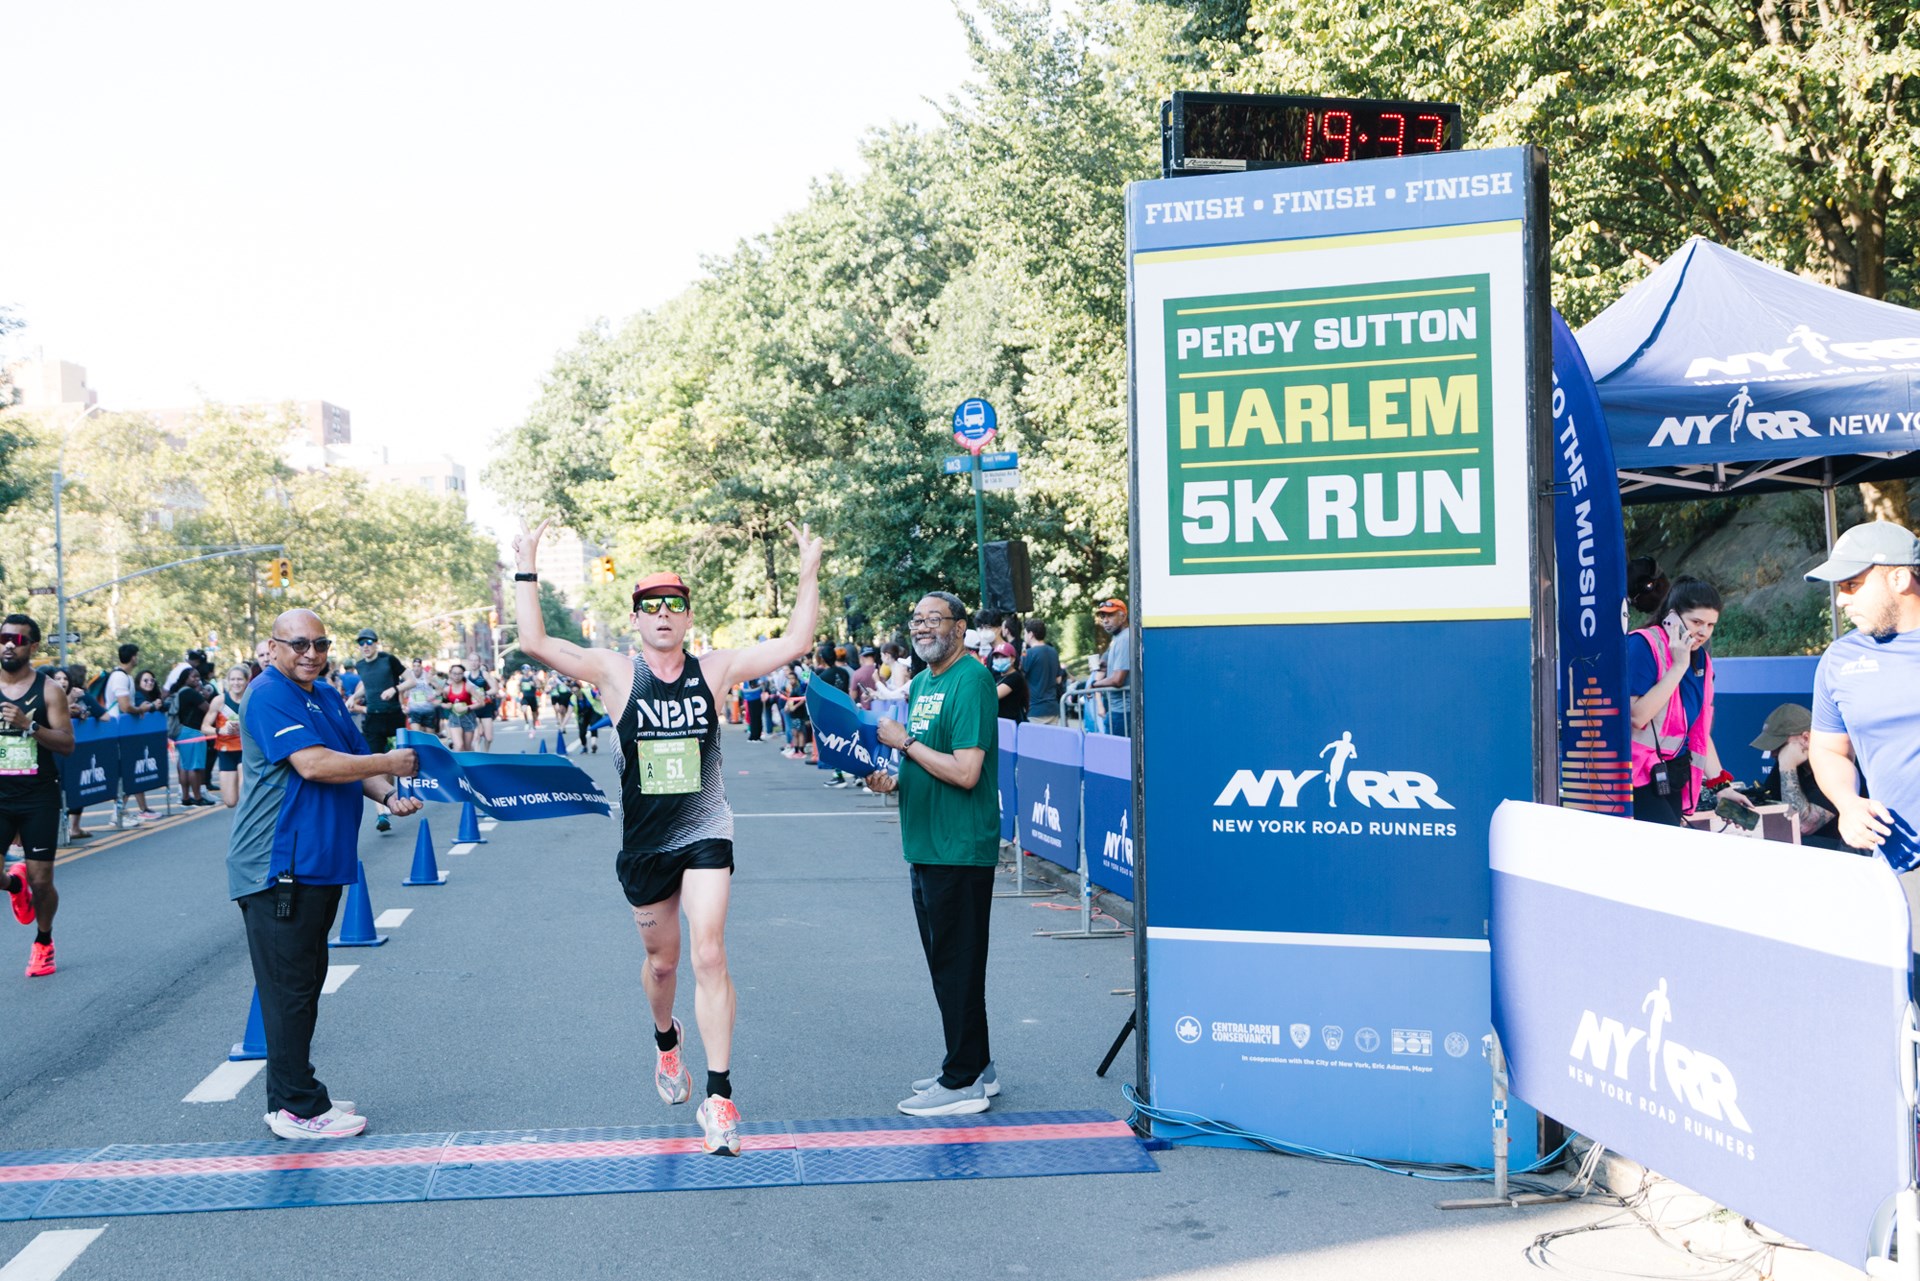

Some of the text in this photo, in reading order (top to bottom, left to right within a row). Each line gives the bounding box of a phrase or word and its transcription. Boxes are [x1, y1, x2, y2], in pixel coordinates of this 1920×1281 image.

[1145, 172, 1512, 224] FINISH FINISH FINISH
[1177, 307, 1476, 360] PERCY SUTTON
[1179, 374, 1479, 449] HARLEM
[1648, 410, 1822, 447] NYRR
[1829, 413, 1890, 436] NEW
[1182, 468, 1480, 544] 5K RUN
[1560, 415, 1587, 497] THE
[1575, 500, 1596, 637] MUSIC
[636, 695, 708, 728] NBR
[666, 758, 685, 779] 51
[492, 796, 517, 807] NEW
[519, 793, 552, 805] YORK
[552, 792, 582, 802] ROAD
[1213, 770, 1456, 809] NYRR
[1212, 819, 1456, 836] NEW YORK ROAD RUNNERS
[1211, 1021, 1272, 1034] CENTRAL PARK
[1212, 1031, 1272, 1044] CONSERVANCY
[1393, 1037, 1431, 1053] DOT
[1249, 1055, 1287, 1064] cooperation
[1315, 1059, 1328, 1067] City
[1353, 1061, 1370, 1069] York,
[1412, 1065, 1432, 1073] Mayor
[1569, 1009, 1752, 1133] NYRR
[1568, 1064, 1755, 1161] NEW YORK ROAD RUNNERS
